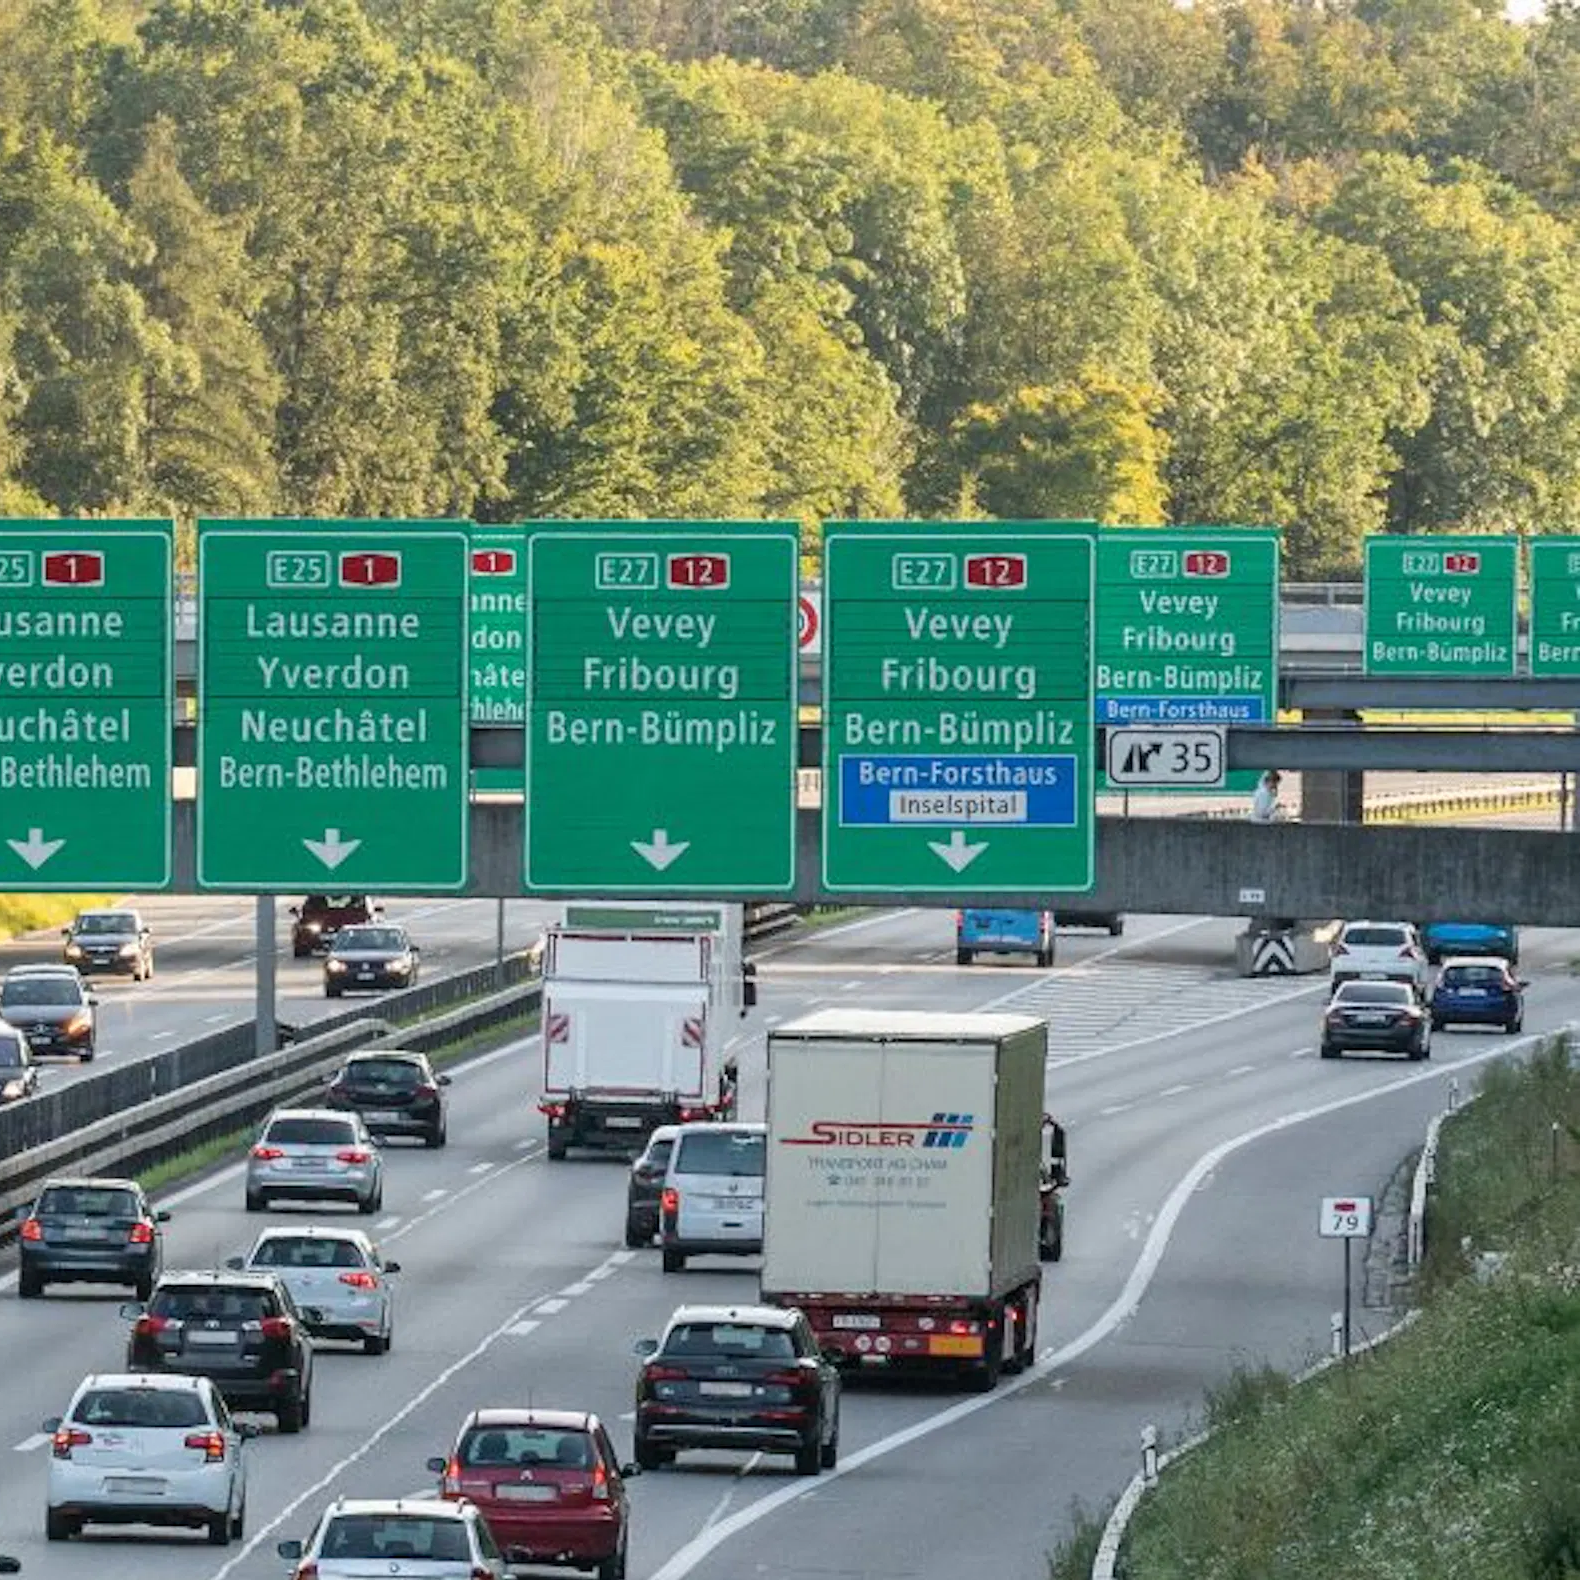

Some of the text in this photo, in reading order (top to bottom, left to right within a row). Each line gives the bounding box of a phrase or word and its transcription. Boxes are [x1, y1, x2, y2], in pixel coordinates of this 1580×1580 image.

[66, 557, 78, 580] 1
[273, 557, 375, 581] E25 1
[488, 552, 497, 571] 1
[602, 560, 712, 583] E27 12
[900, 560, 1009, 584] E27 12
[1137, 556, 1217, 573] E27 12
[1452, 556, 1471, 571] 12
[1139, 590, 1218, 620] Vevey
[1410, 583, 1472, 605] Vevey
[247, 604, 419, 638] Lausanne
[607, 607, 716, 648] Vevey
[905, 607, 1012, 648] Vevey
[1396, 611, 1485, 635] Fribourg
[1122, 625, 1236, 656] Fribourg
[258, 655, 408, 689] Yverdon
[584, 657, 739, 699] Fribourg
[882, 657, 1036, 699] Fribourg
[1096, 664, 1263, 693] Bern-Bümpliz
[1107, 700, 1250, 719] Bern-Forsthaus
[241, 708, 426, 742] Neuchâtel
[547, 711, 776, 752] Bern-Bümpliz
[845, 711, 1076, 753] Bern-Bümpliz
[220, 755, 447, 789] Bern-Bethlehem
[1171, 743, 1212, 772] 35
[859, 760, 1057, 785] Bern-Forsthaus
[900, 795, 1017, 819] Inselspital
[1332, 1214, 1359, 1231] 79
